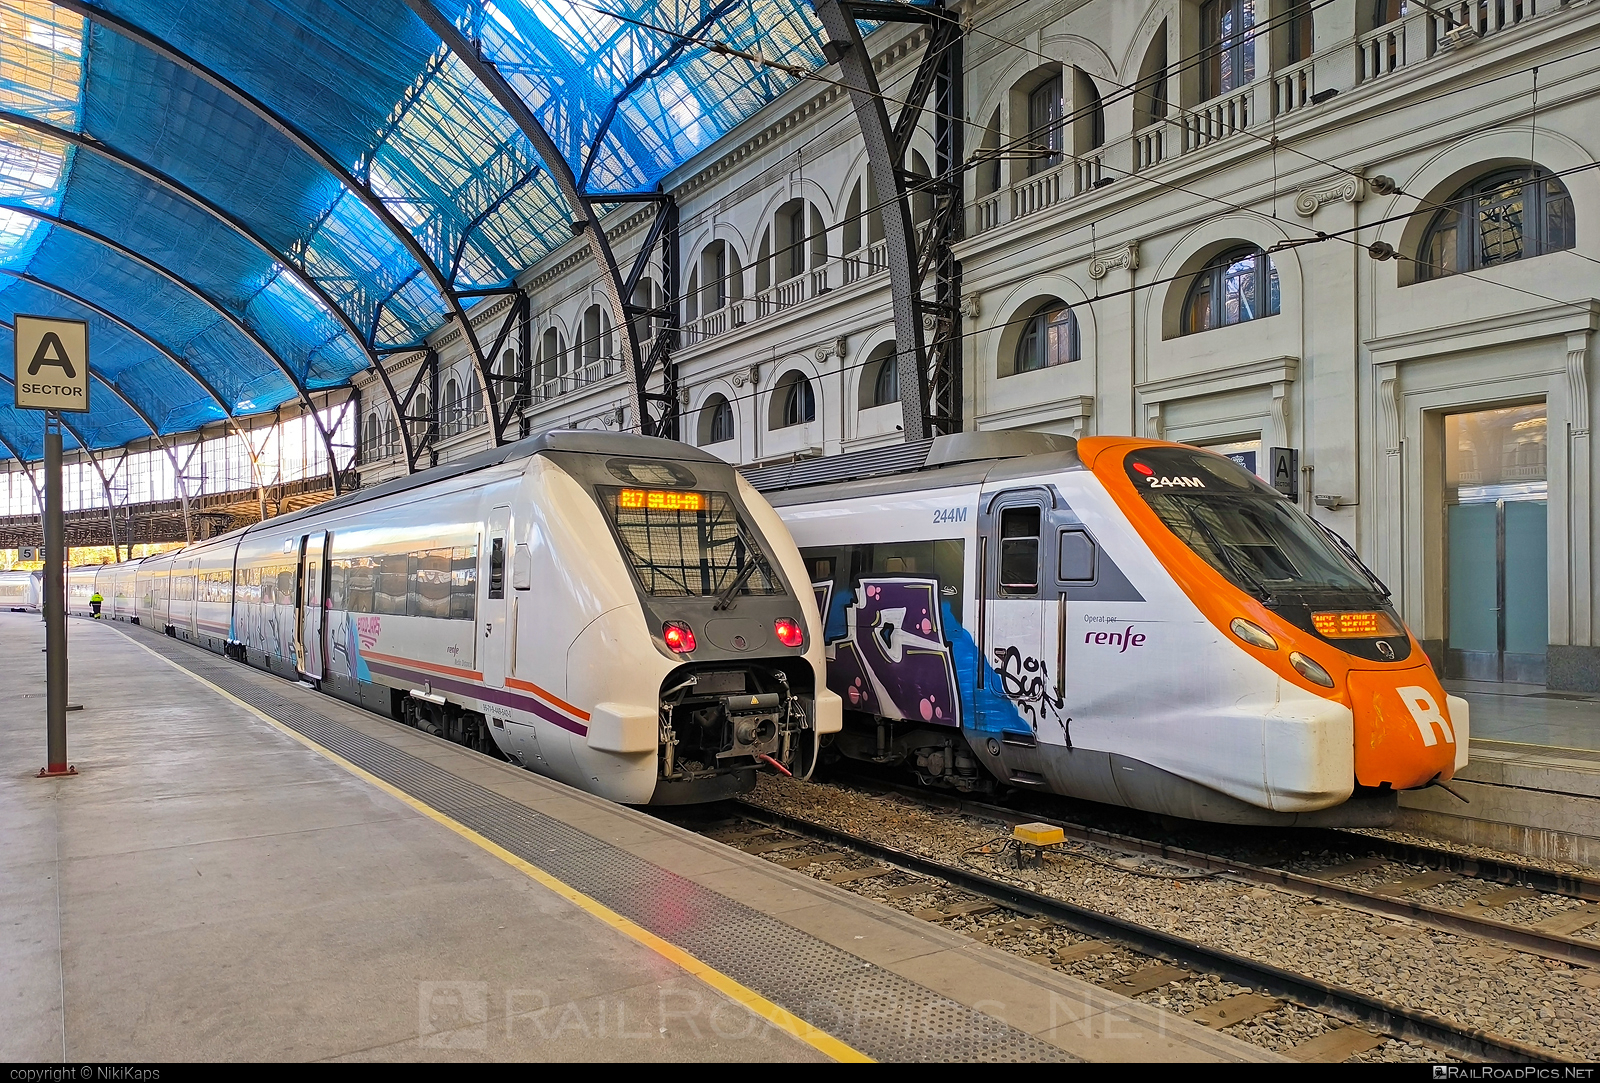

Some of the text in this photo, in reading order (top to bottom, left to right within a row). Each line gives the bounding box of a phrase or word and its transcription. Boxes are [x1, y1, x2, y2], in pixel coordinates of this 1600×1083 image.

[28, 332, 76, 378] A
[22, 383, 83, 397] SECTOR
[1276, 455, 1289, 478] A
[1146, 476, 1206, 488] 244M
[622, 492, 698, 509] R17 SALOU-PA
[933, 507, 967, 523] 244M
[23, 549, 31, 558] 5
[1084, 614, 1117, 624] Operat per
[1085, 625, 1146, 653] renfe
[1395, 685, 1455, 747] R
